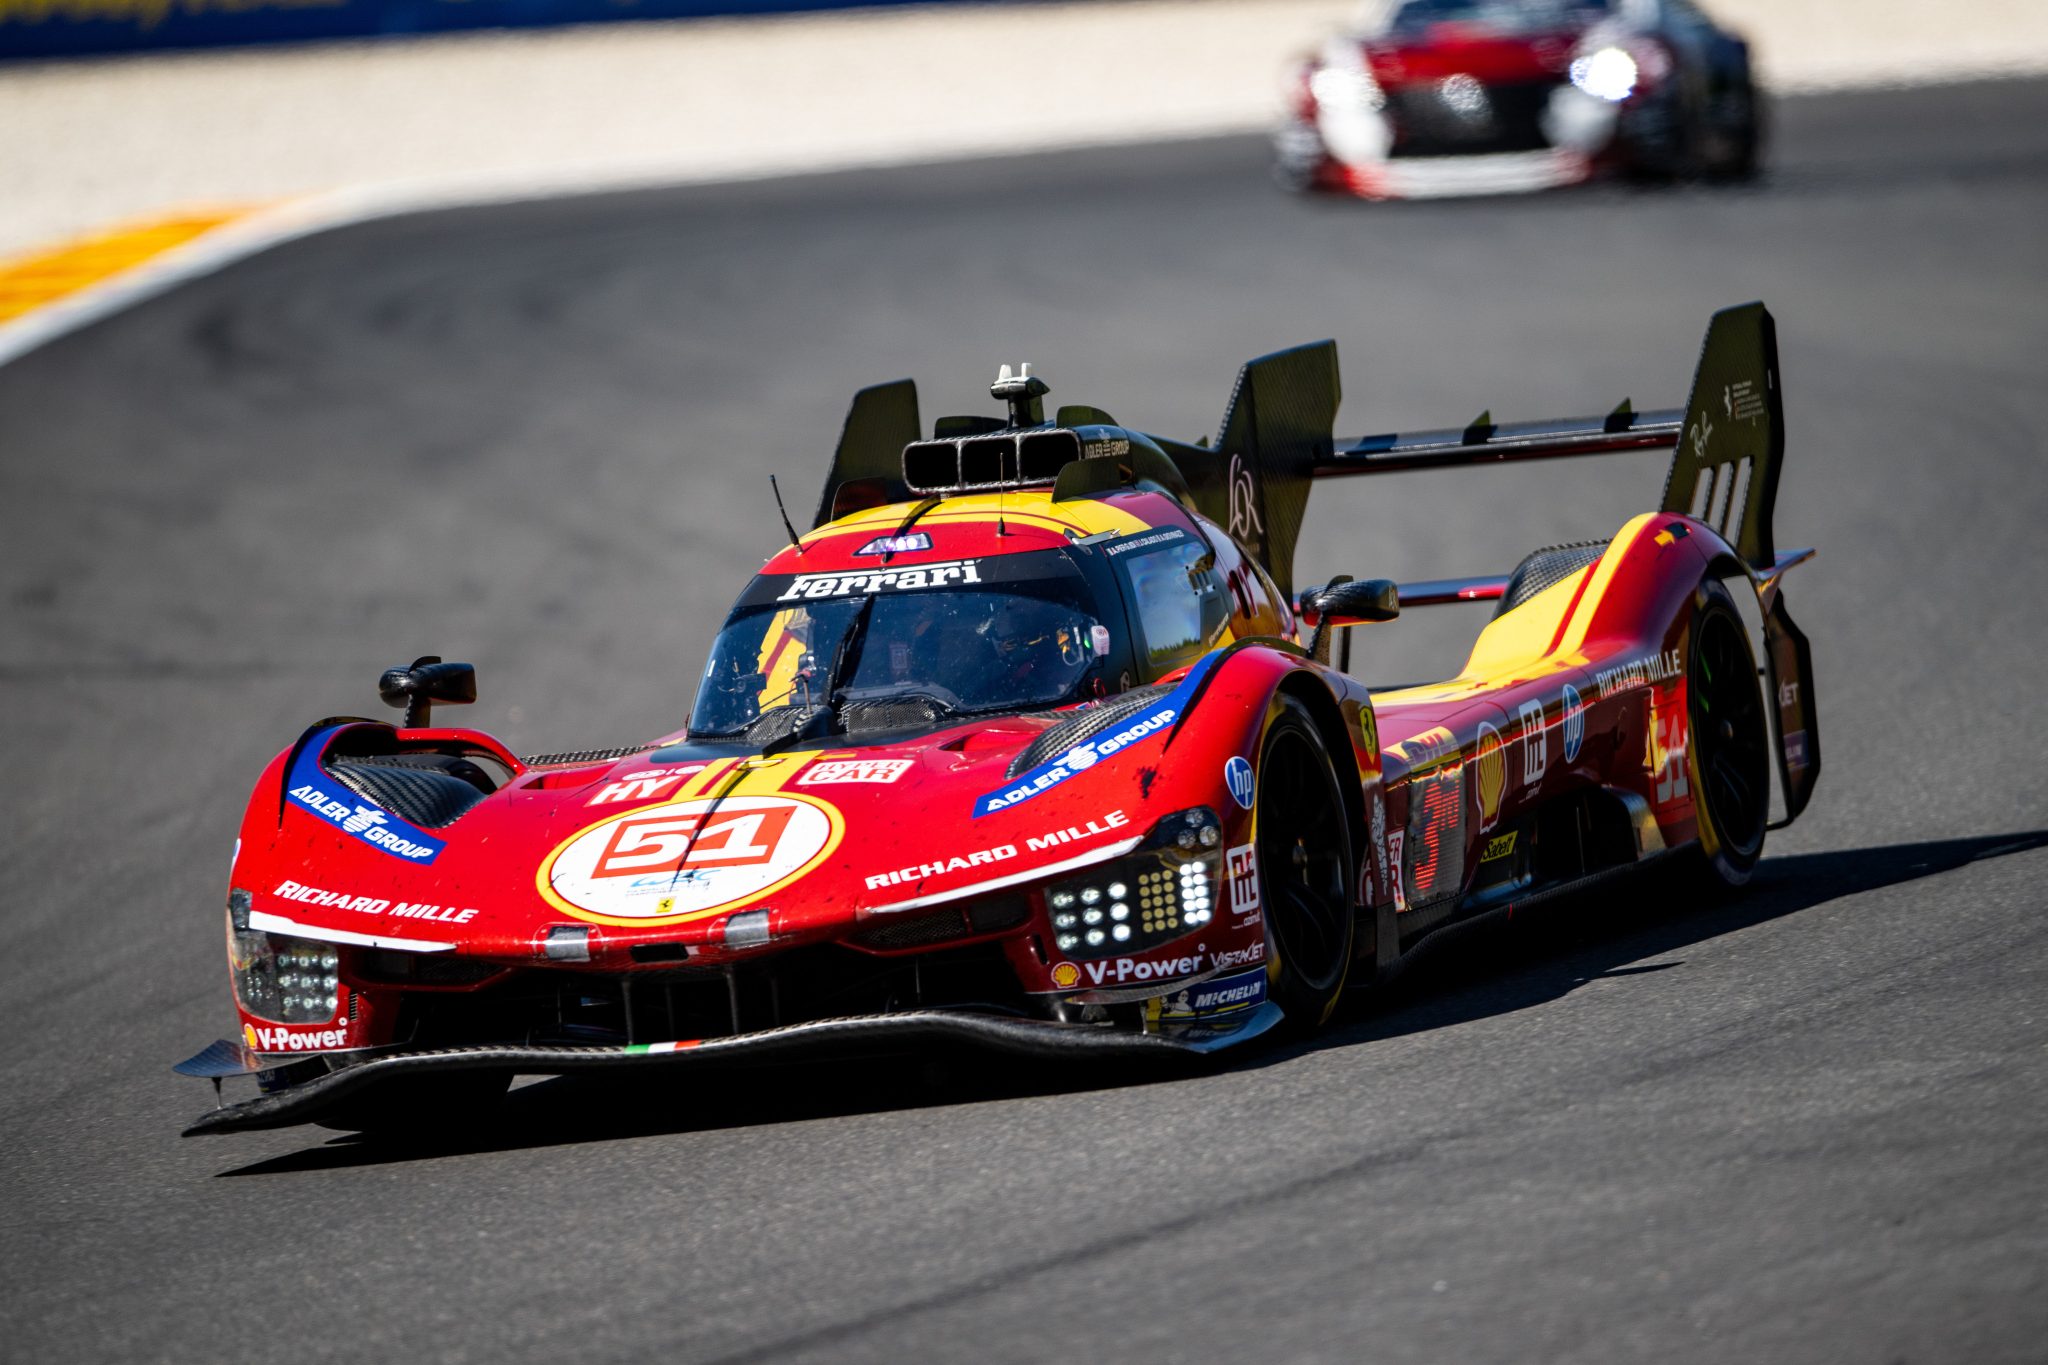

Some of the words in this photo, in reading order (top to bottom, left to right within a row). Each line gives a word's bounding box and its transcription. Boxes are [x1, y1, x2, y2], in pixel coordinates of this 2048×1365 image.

[776, 559, 984, 601] Ferrari
[1596, 659, 1646, 698] RICHARD
[1646, 649, 1682, 682] MILLE
[807, 768, 896, 782] CAR
[986, 765, 1071, 812] ADLER
[1096, 708, 1177, 756] GROUP
[1234, 763, 1252, 799] hp
[590, 775, 682, 805] HY
[289, 784, 352, 822] ADLER
[363, 826, 435, 859] GROUP
[604, 812, 769, 870] 51
[864, 843, 1018, 891] RICHARD
[1025, 809, 1131, 852] MILLE
[273, 879, 391, 914] RICHARD
[388, 902, 480, 924] MILLE
[1085, 953, 1203, 985] V-Power
[1195, 981, 1261, 1008] MICHELIN
[256, 1027, 348, 1051] V-Power
